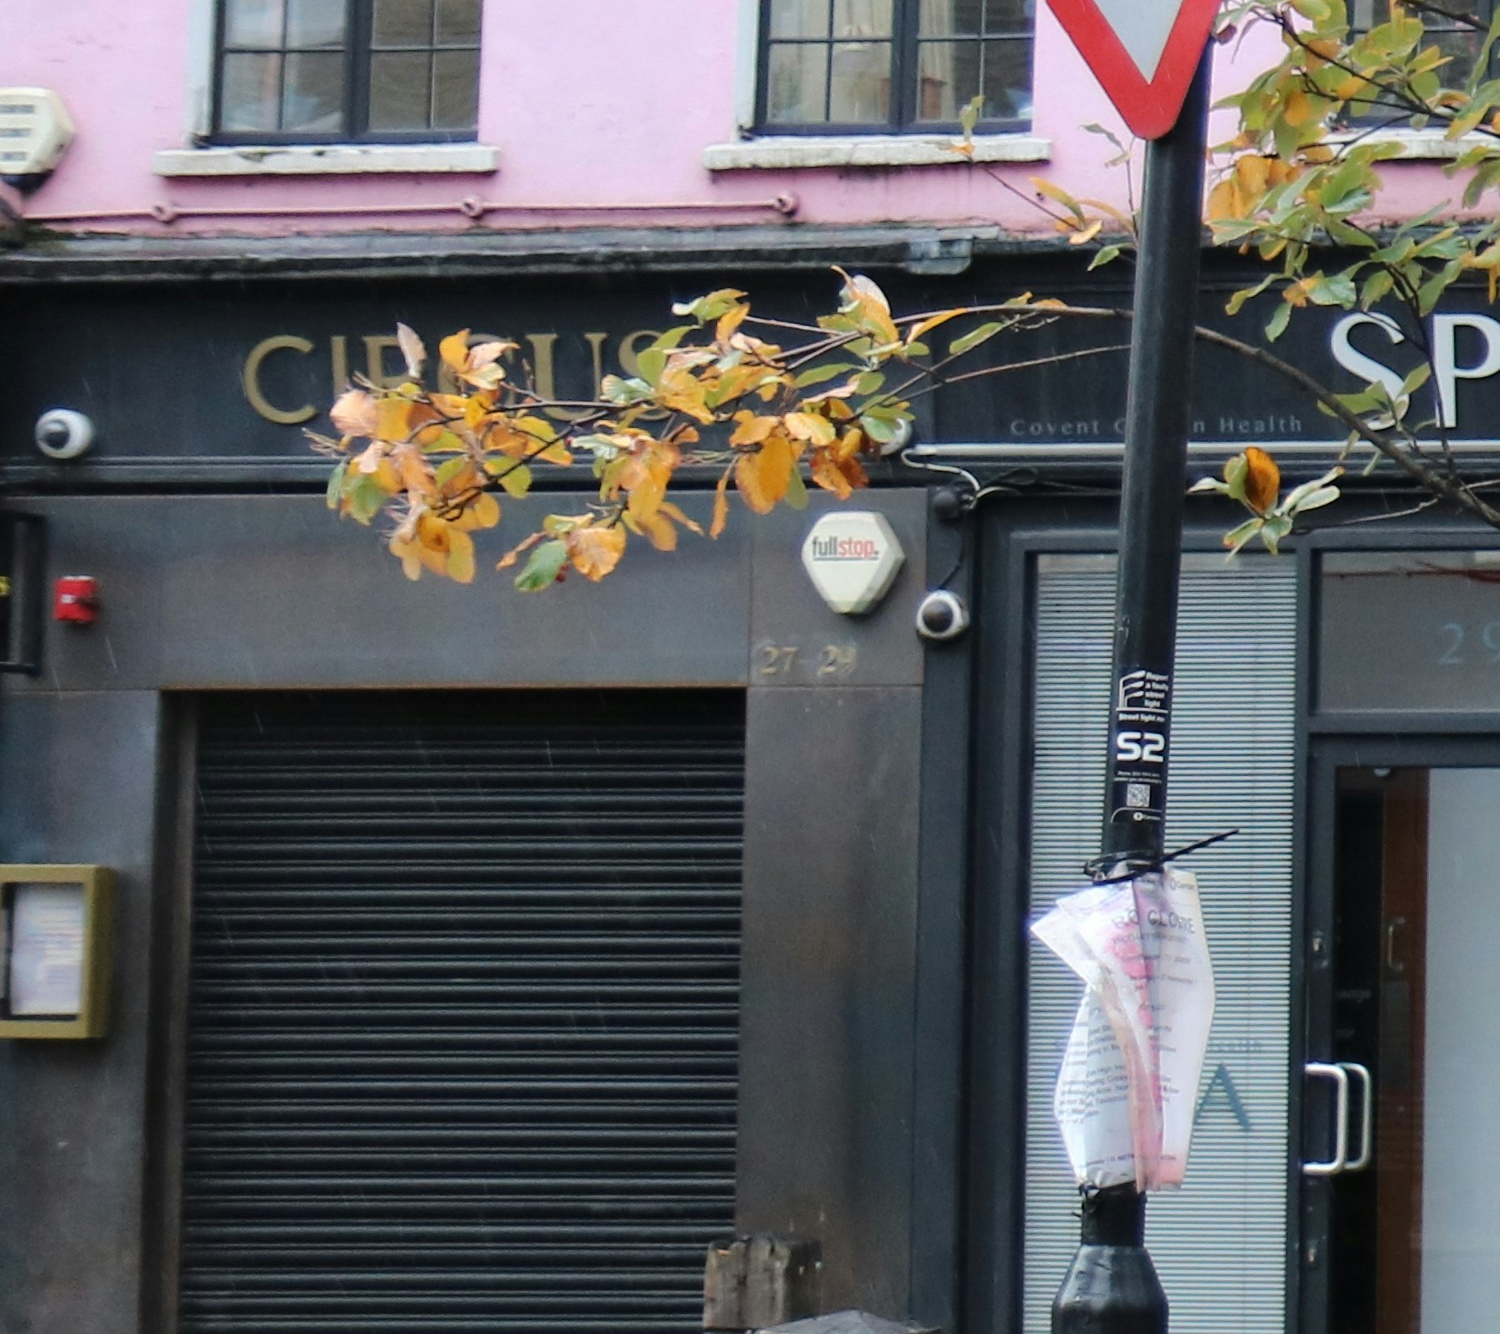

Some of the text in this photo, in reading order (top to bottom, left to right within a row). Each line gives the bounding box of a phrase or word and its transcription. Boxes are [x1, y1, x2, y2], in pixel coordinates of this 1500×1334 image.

[1010, 419, 1100, 436] Covent
[1219, 415, 1302, 433] Health
[761, 646, 798, 675] 27
[1117, 731, 1165, 762] S2
